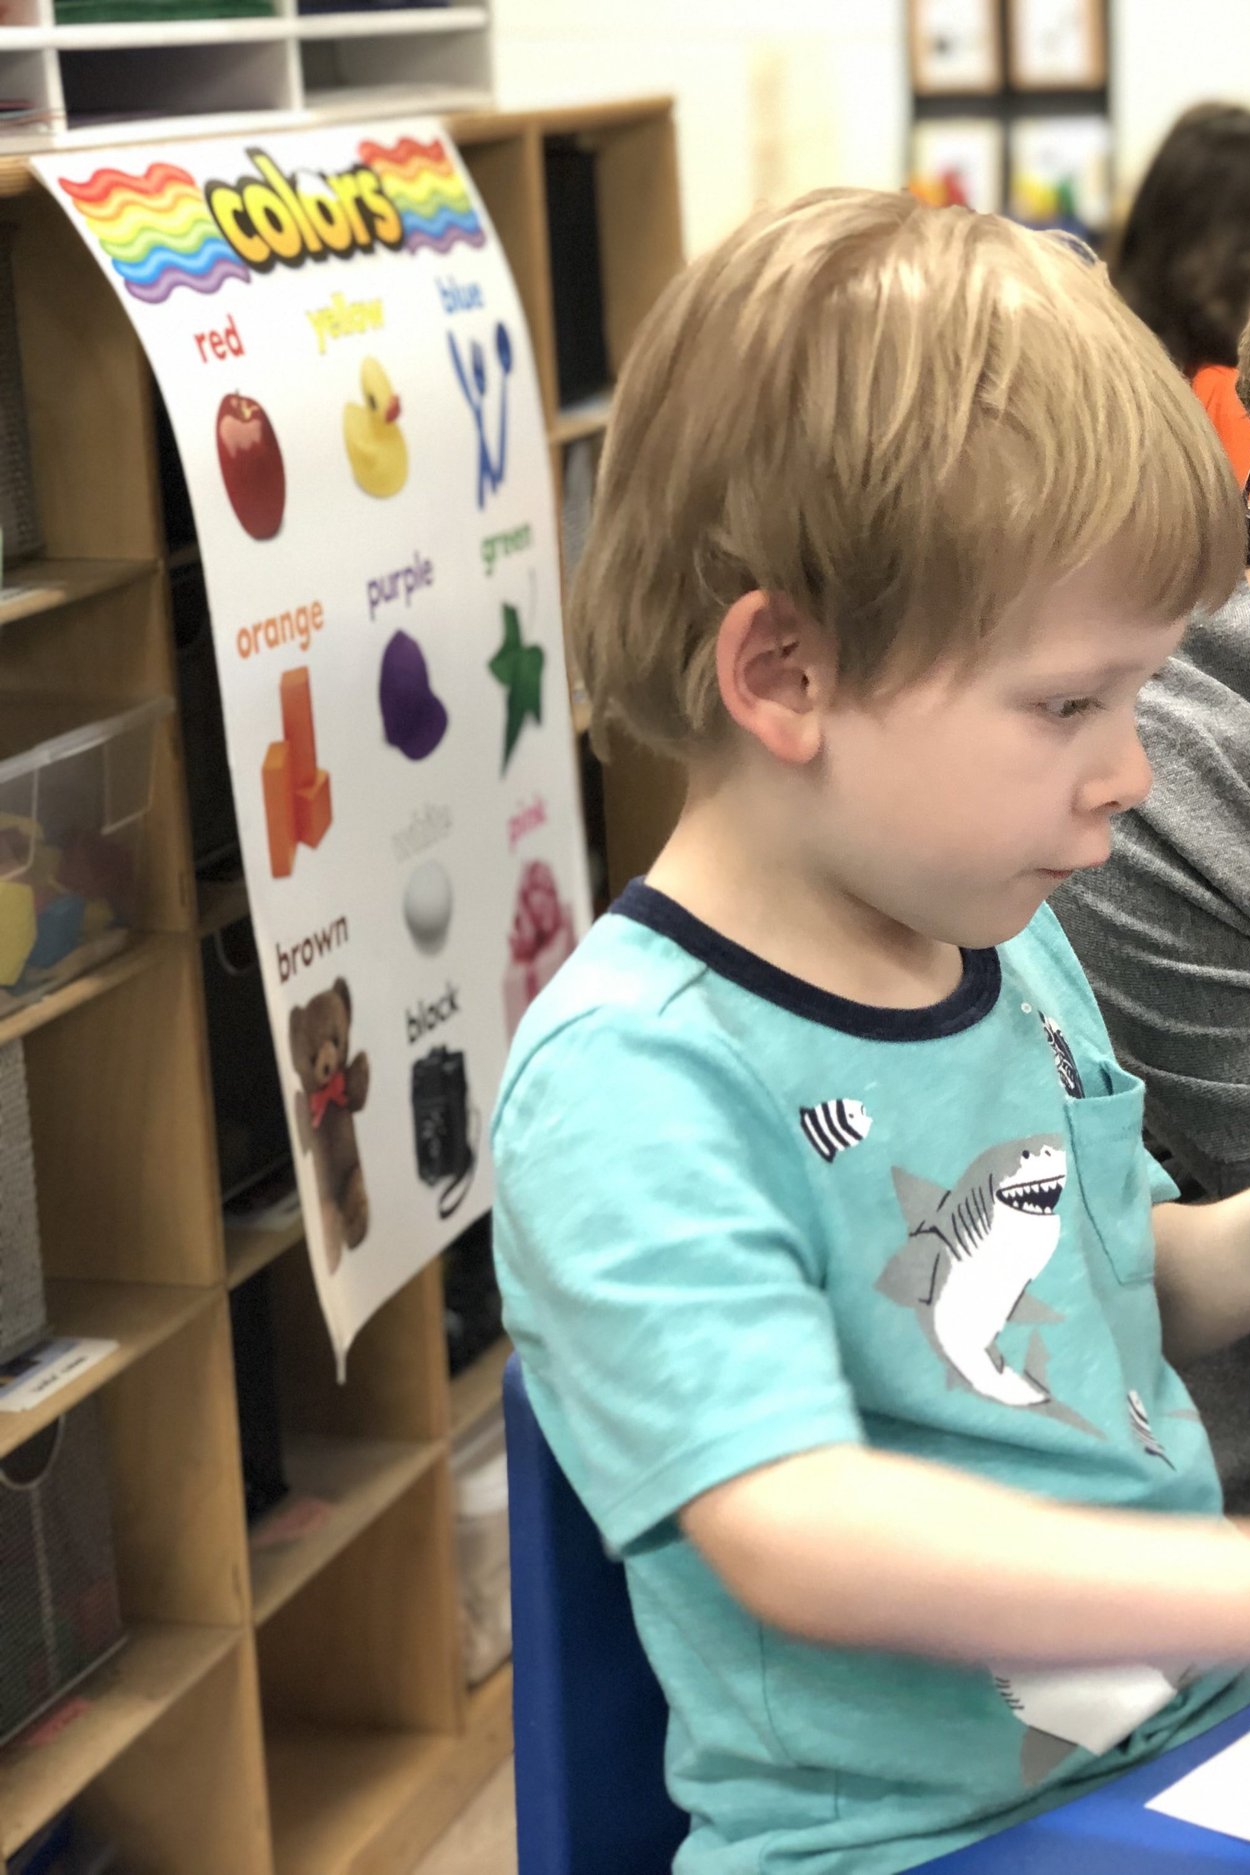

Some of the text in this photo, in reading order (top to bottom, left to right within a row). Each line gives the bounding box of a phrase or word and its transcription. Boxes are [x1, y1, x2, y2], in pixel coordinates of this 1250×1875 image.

[205, 147, 405, 274] colors
[306, 291, 385, 354] yellow
[434, 274, 485, 315] blue
[194, 313, 245, 363] red
[481, 523, 531, 577] green
[367, 550, 432, 621] purple
[236, 601, 323, 659] orange
[276, 916, 349, 983] brown
[406, 981, 459, 1044] black
